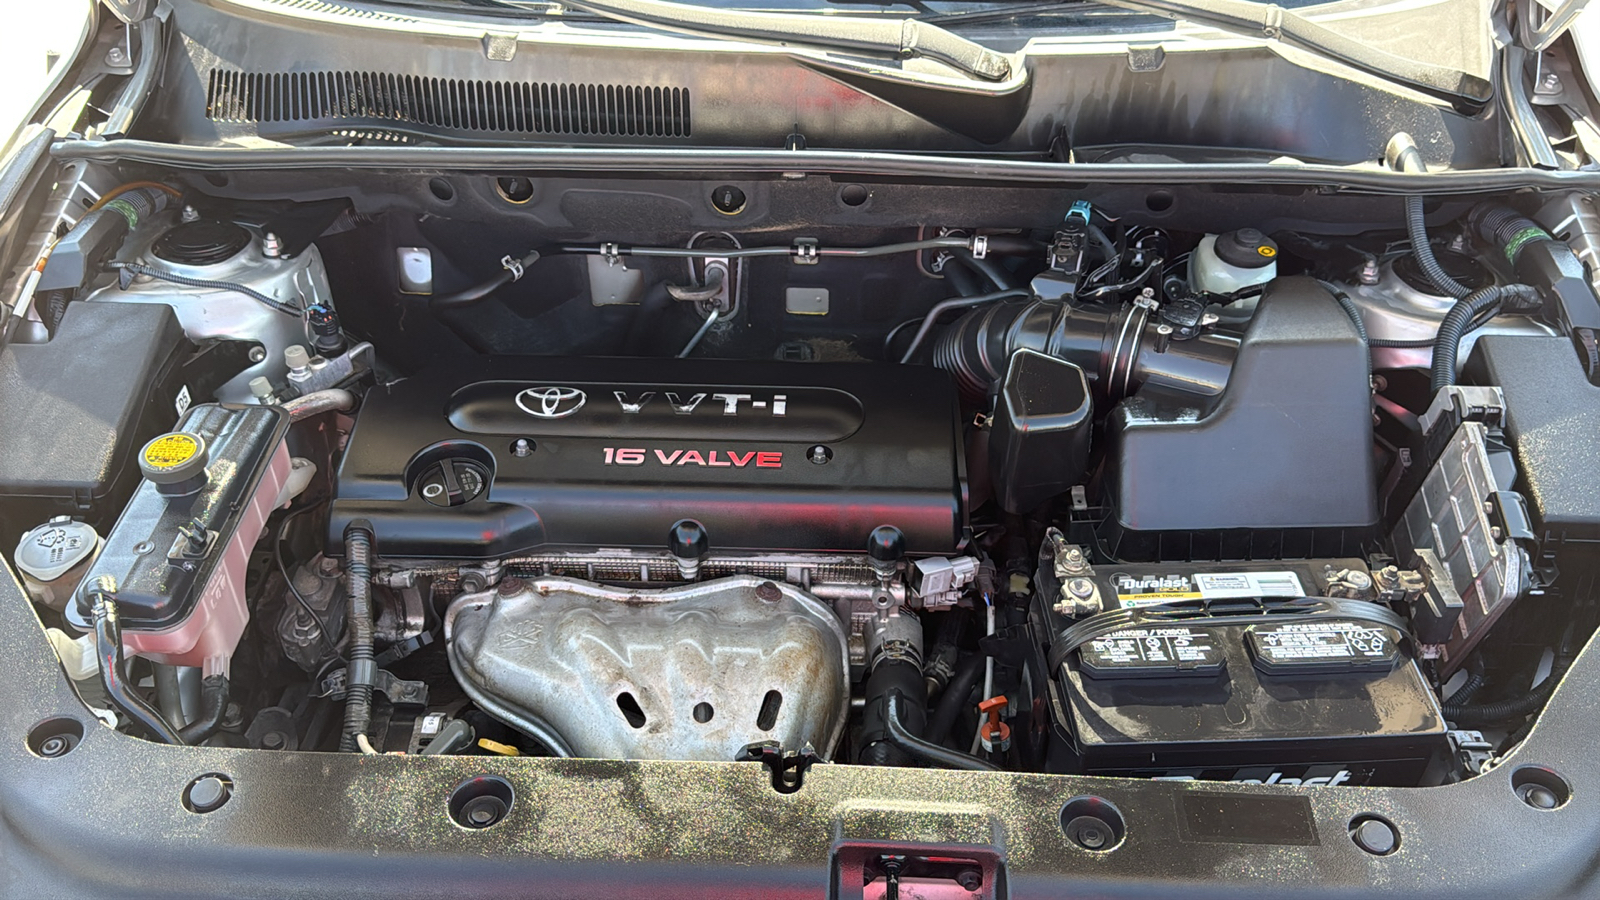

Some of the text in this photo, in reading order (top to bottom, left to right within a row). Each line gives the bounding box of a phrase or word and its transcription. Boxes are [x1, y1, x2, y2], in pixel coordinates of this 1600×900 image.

[613, 391, 787, 417] VVT-i
[603, 447, 783, 468] 16 VALVE
[1119, 576, 1189, 589] Duralast
[1112, 629, 1148, 637] DANGER
